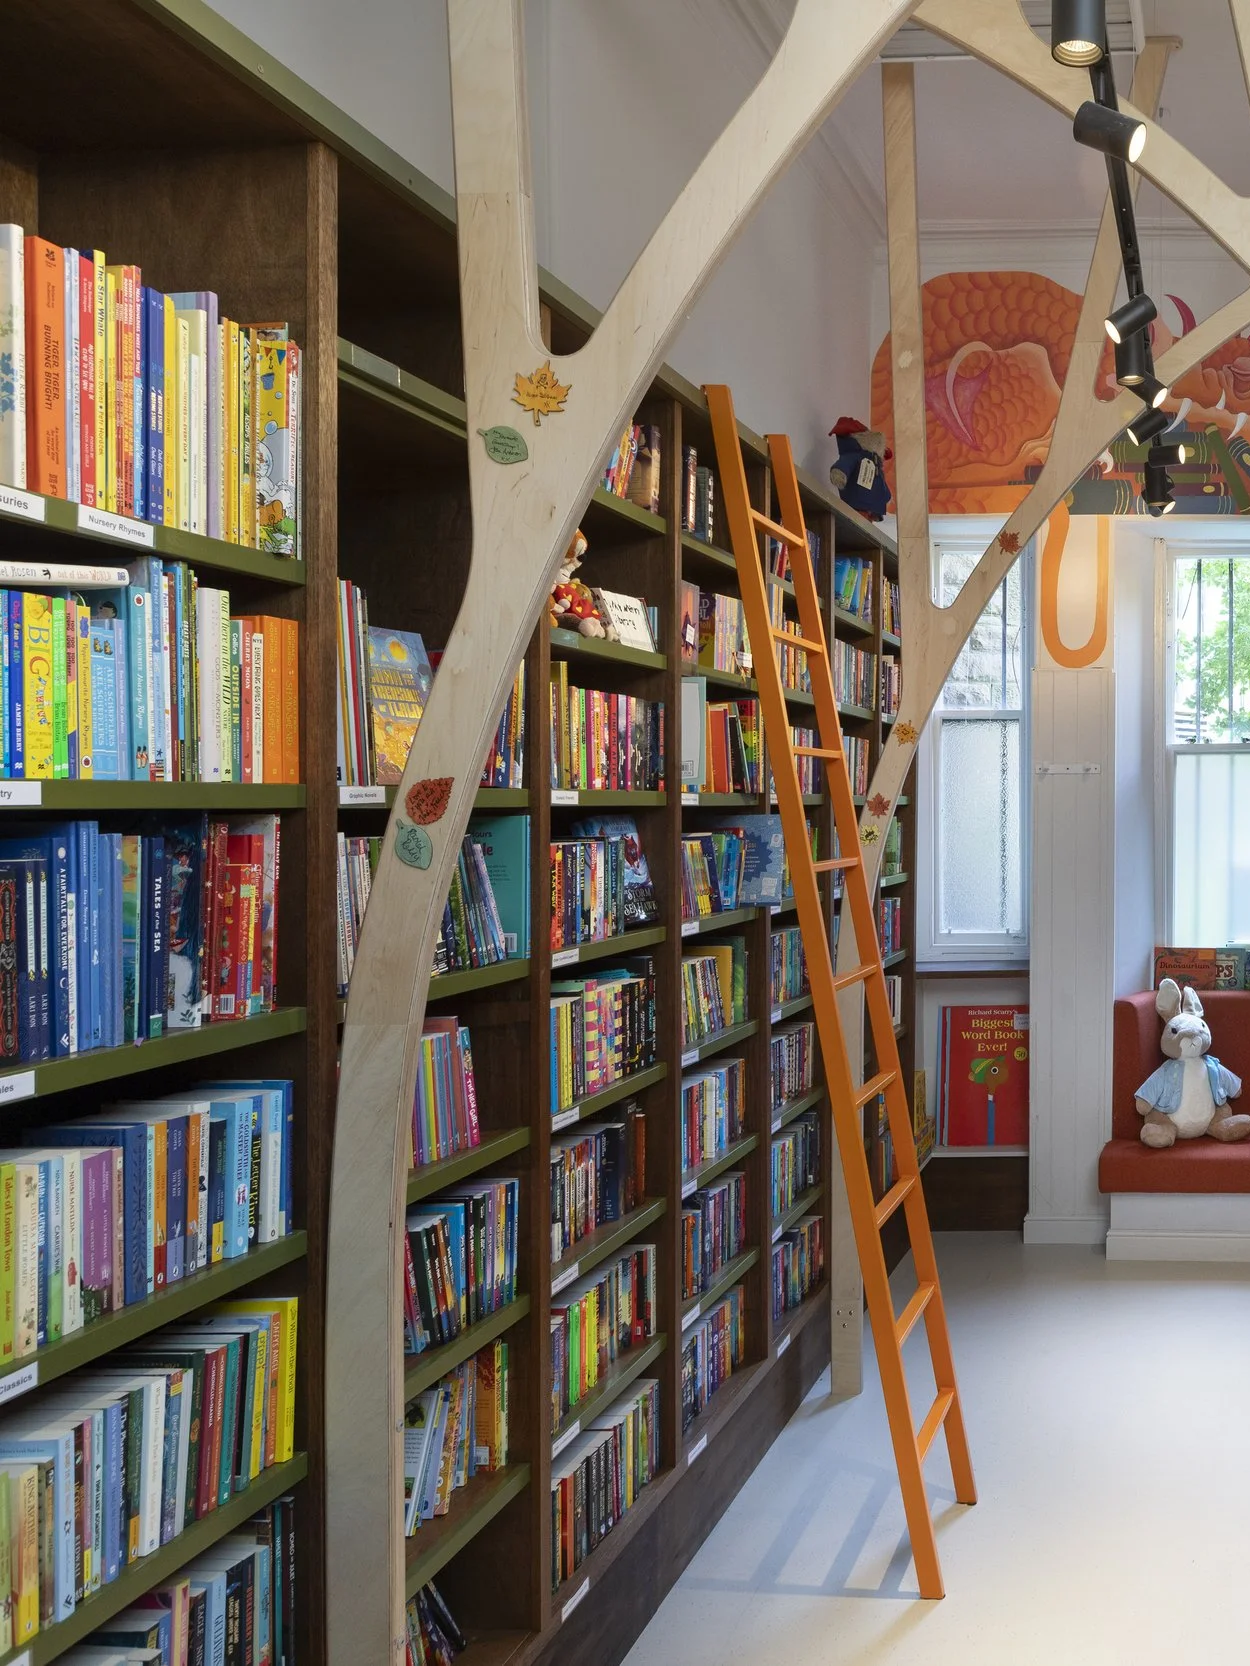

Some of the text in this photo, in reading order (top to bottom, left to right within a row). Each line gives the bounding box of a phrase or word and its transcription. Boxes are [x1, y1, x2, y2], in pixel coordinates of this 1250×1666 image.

[44, 372, 52, 410] BRIGHT!
[0, 496, 28, 509] suries
[88, 515, 146, 537] Nursery Rhymes
[11, 566, 37, 579] Rosen
[221, 595, 230, 613] Out
[221, 618, 230, 644] There
[28, 625, 50, 677] BIG
[221, 657, 230, 673] the
[221, 675, 230, 704] WILD
[972, 1019, 1013, 1029] Biggest
[962, 1031, 1024, 1040] Word Book
[978, 1043, 1007, 1051] Ever!
[0, 1085, 14, 1094] les
[466, 1079, 478, 1127] THE NEW GIRL
[250, 1140, 260, 1189] The Letter
[248, 1192, 258, 1225] King
[4, 1177, 13, 1271] Tales of London Town
